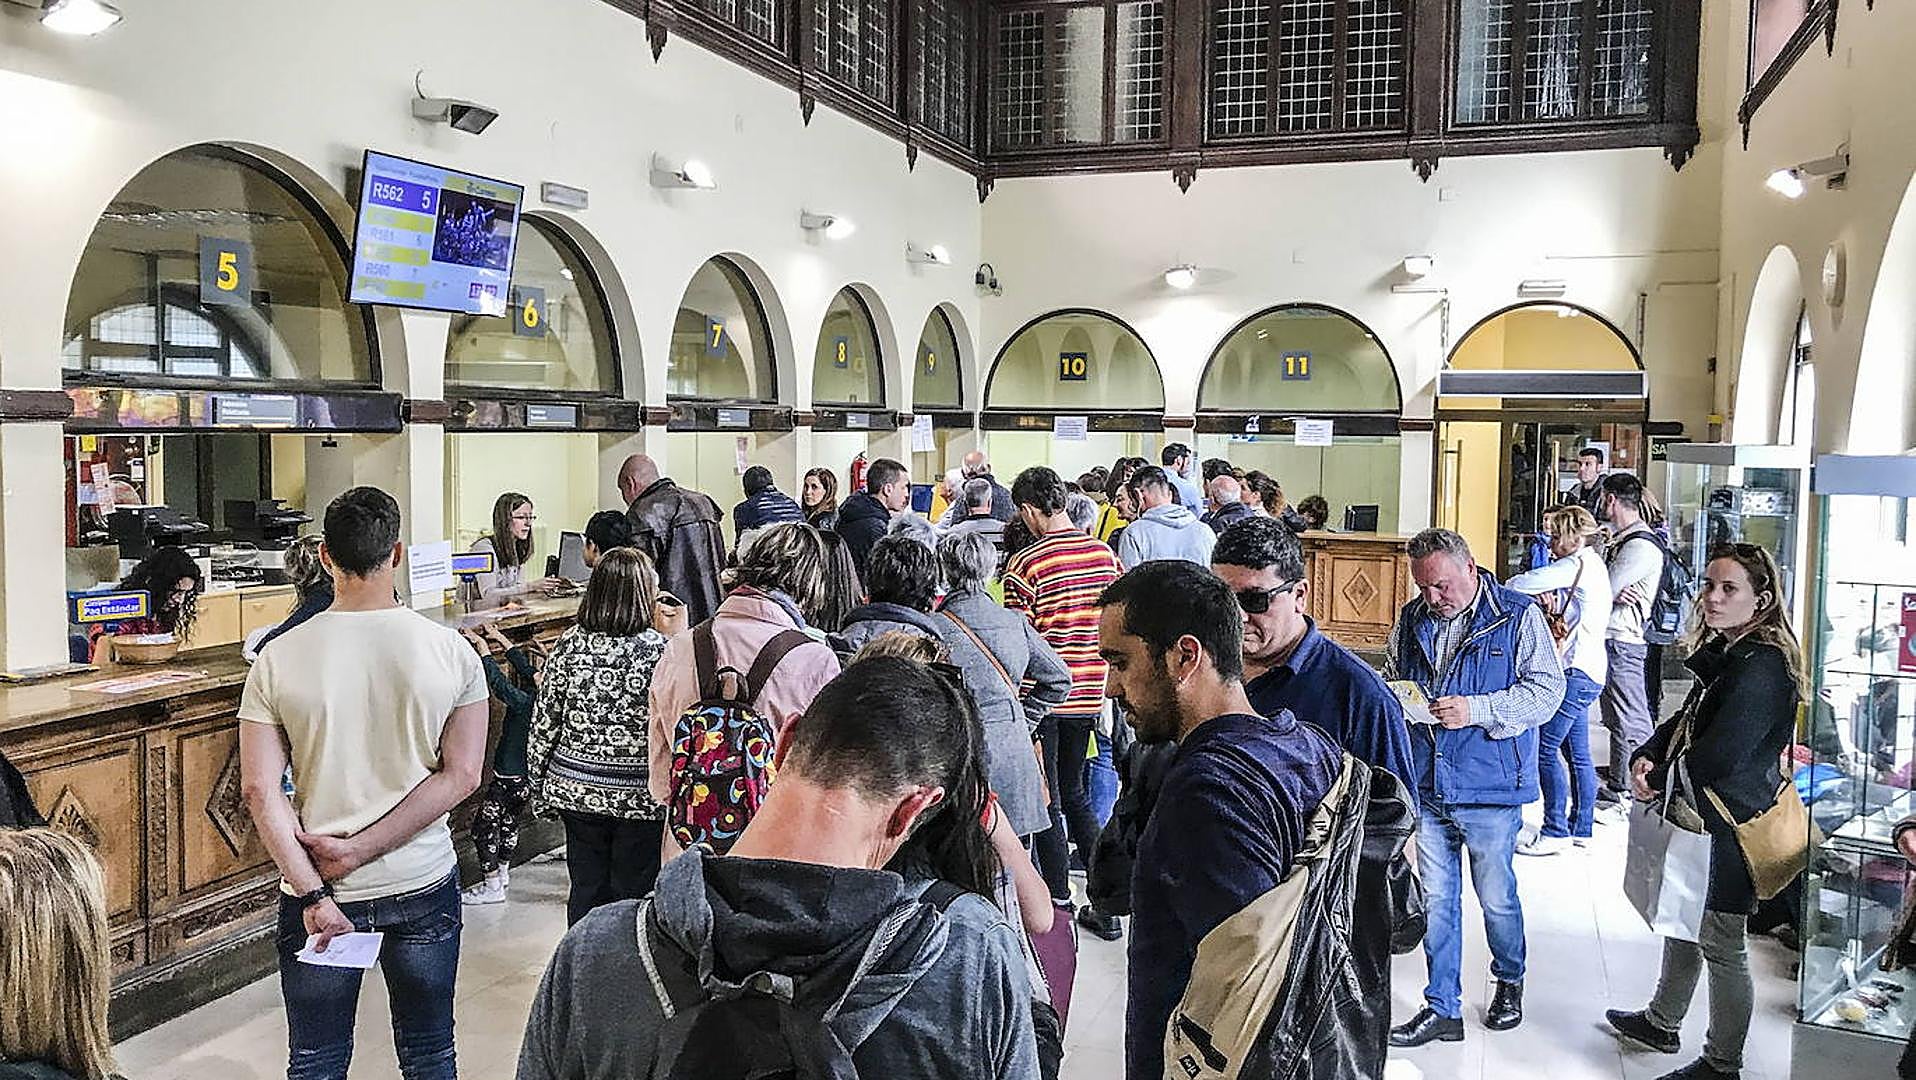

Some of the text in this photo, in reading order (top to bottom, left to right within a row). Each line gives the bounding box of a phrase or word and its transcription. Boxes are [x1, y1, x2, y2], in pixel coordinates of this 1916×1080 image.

[373, 182, 432, 209] R562 5
[217, 251, 239, 291] 5
[523, 298, 538, 328] 6
[712, 324, 723, 348] 7
[838, 341, 846, 362] 8
[928, 352, 935, 371] 9
[1061, 357, 1086, 376] 10
[1285, 356, 1308, 376] 11
[1651, 443, 1667, 455] SA
